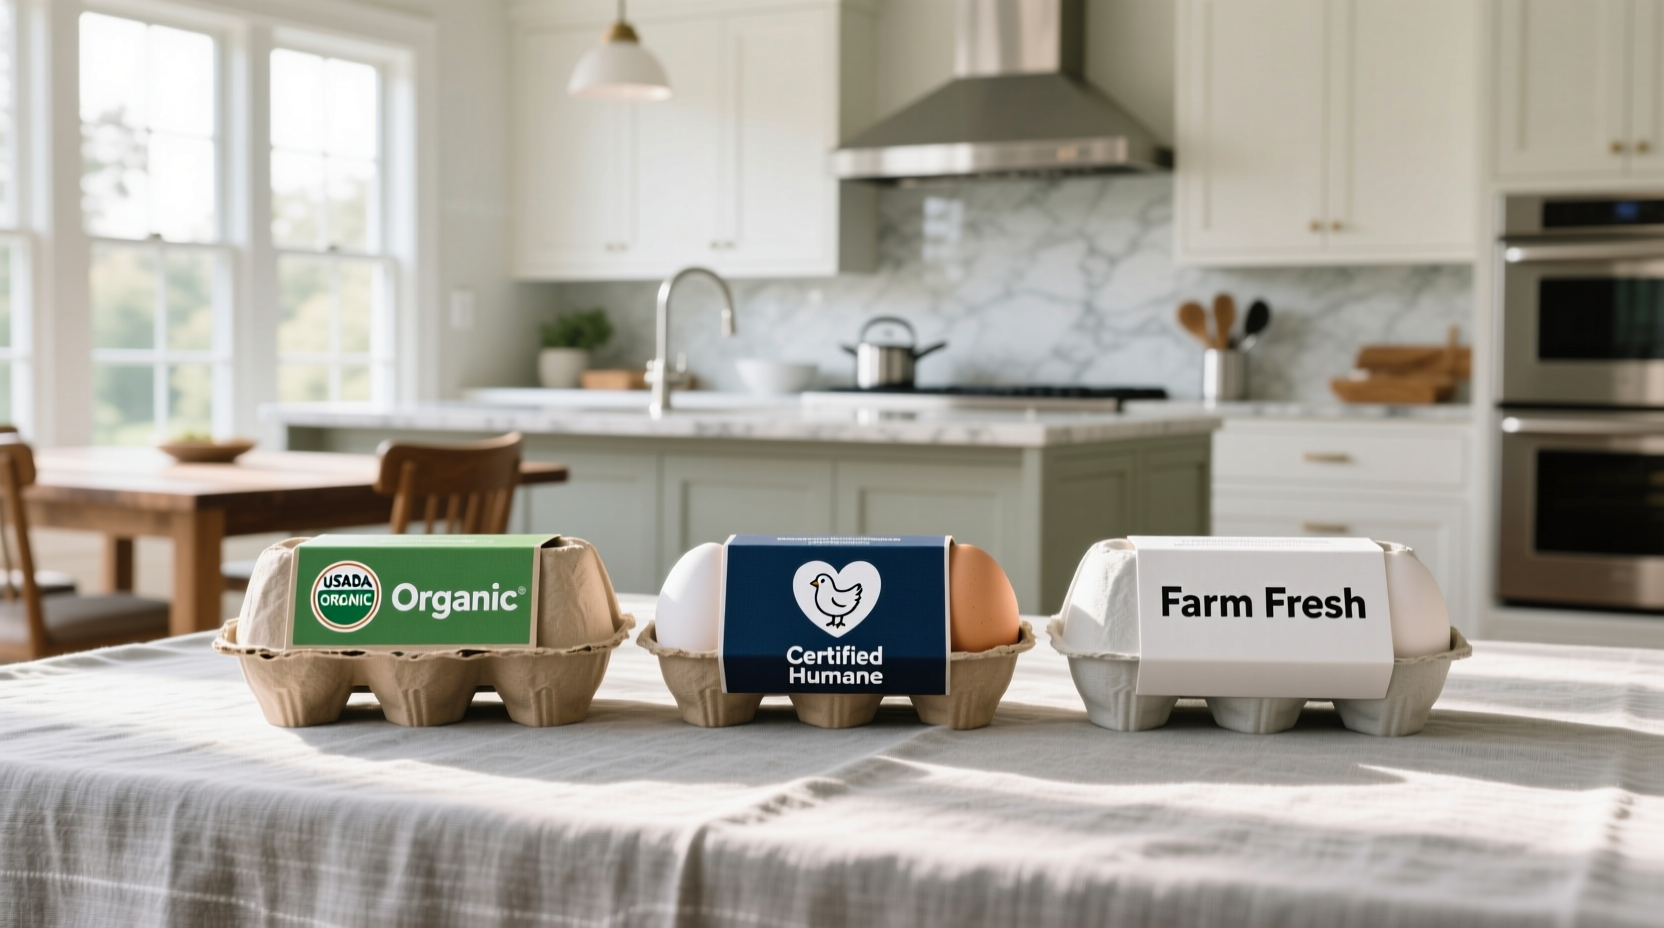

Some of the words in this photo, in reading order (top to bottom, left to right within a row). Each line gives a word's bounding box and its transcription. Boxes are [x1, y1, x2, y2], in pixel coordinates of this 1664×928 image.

[323, 574, 373, 588] USADA
[1161, 586, 1253, 617] Farm
[1265, 587, 1367, 618] Fresh
[786, 645, 883, 665] Certified
[789, 667, 883, 684] Humane
